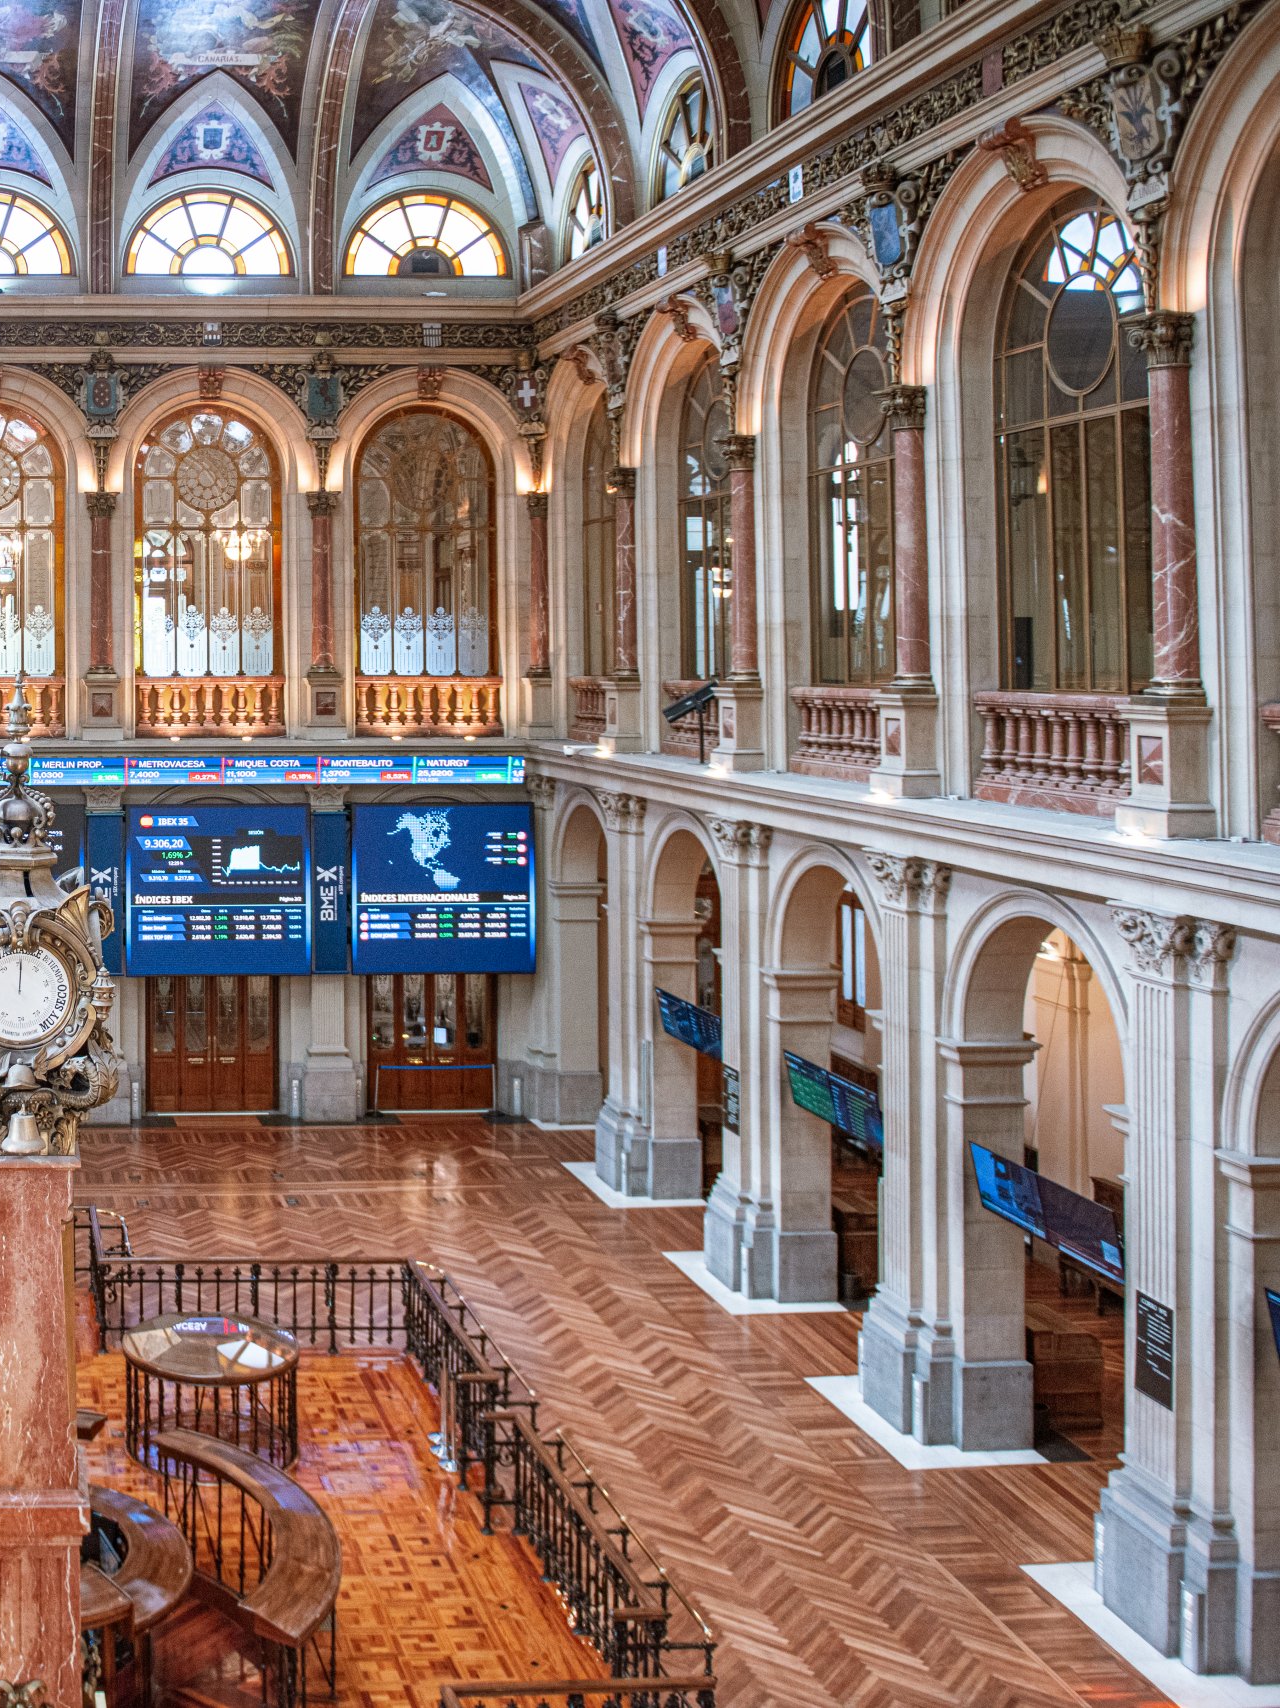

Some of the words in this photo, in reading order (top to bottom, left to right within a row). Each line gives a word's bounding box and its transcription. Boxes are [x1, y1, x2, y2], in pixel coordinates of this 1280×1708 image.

[138, 760, 206, 768] METROVACESA
[235, 760, 268, 768] MIQUEL
[145, 839, 183, 849] 9.306,20
[135, 894, 170, 904] ÍNDICES
[172, 896, 193, 904] IBEX
[361, 893, 396, 902] ÍNDICES
[398, 894, 479, 902] INTERNACIONALES
[320, 886, 334, 920] BME
[39, 1010, 59, 1033] MUY
[55, 984, 67, 1012] SECO
